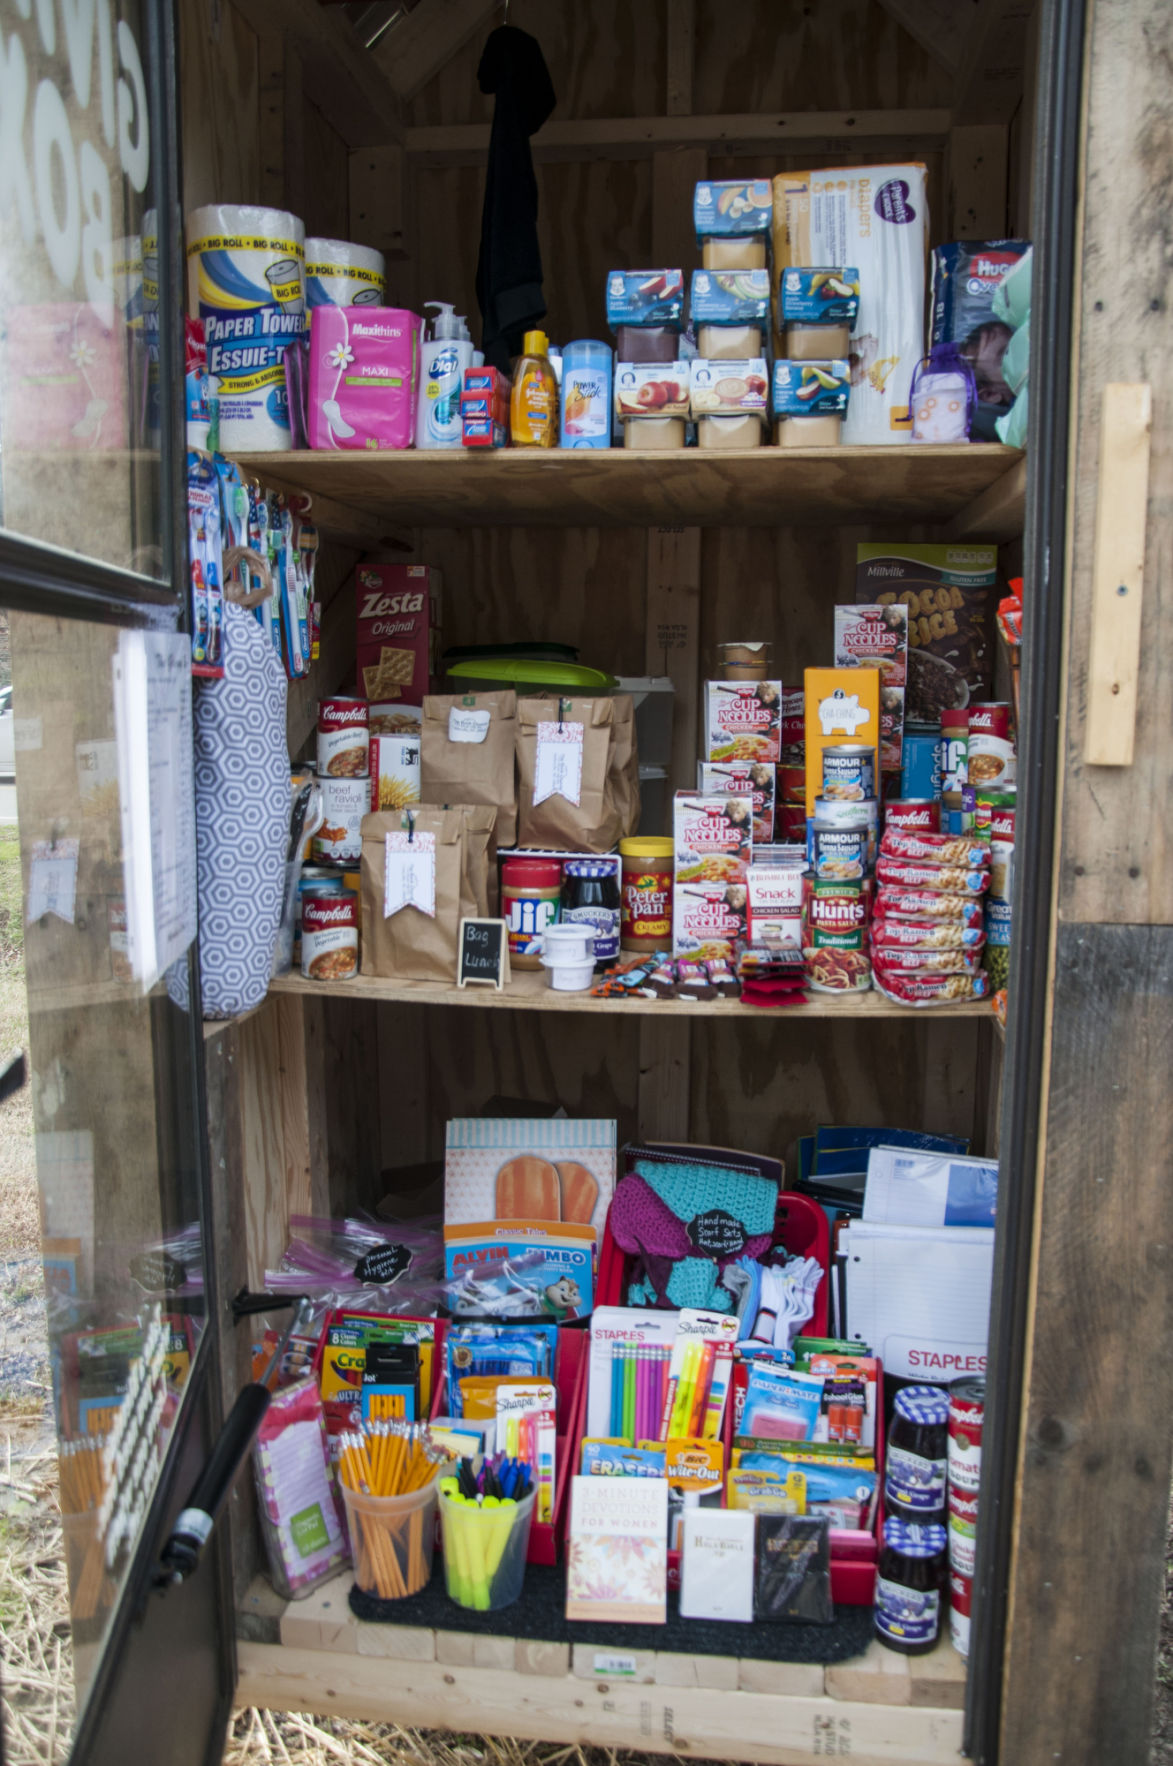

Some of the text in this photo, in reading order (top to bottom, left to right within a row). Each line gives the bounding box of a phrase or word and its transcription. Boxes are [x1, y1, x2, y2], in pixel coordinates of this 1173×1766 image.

[858, 178, 872, 238] Diapers
[208, 239, 288, 251] BIG ROLL BIG ROLL
[315, 266, 334, 275] ROLL
[356, 271, 372, 282] ROLL
[276, 287, 289, 297] BIG
[352, 323, 401, 338] Maxithins
[362, 366, 389, 376] MAXI
[430, 359, 457, 373] Dial
[868, 566, 904, 577] Millville
[359, 591, 424, 618] Zesta
[876, 586, 966, 619] COCOA
[372, 619, 415, 636] Original
[856, 622, 887, 634] CUP
[844, 633, 897, 646] NOODLES
[731, 699, 761, 712] CUP
[323, 705, 368, 722] Campbell's
[719, 710, 772, 723] NOODLES
[943, 741, 968, 770] if
[824, 758, 861, 767] ARMOUR
[931, 744, 942, 800] spaghe
[329, 785, 351, 796] beef
[335, 793, 363, 804] ravioli
[886, 808, 931, 826] Campbell's
[698, 817, 730, 830] CUP
[684, 829, 741, 843] NOODLES
[819, 833, 860, 843] ARMOUR
[907, 848, 925, 857] BEEF
[910, 842, 943, 852] Ramen
[904, 875, 921, 883] BEEF
[906, 868, 940, 879] Ramen
[626, 885, 668, 907] Peter
[755, 887, 796, 900] Snack
[900, 902, 918, 911] BEEF
[904, 896, 936, 907] Ramen
[304, 904, 353, 920] Campbell's
[697, 904, 730, 916] CUP
[812, 899, 864, 920] Hunt's
[505, 902, 554, 933] Jif
[684, 916, 741, 928] NOODLES
[902, 927, 935, 936] Ramen
[989, 923, 1011, 932] SWEE
[315, 936, 341, 949] Vegetable
[466, 926, 489, 947] Bag
[817, 935, 858, 945] Traditional
[900, 934, 918, 943] BEEF
[465, 951, 501, 969] Lunch
[904, 951, 937, 959] Ramen
[902, 958, 920, 966] BEEF
[915, 983, 947, 992] Ramen
[453, 1246, 509, 1267] ALVIN
[595, 1329, 645, 1341] STAPLES
[676, 1322, 717, 1336] Sharpie
[332, 1334, 339, 1344] 8
[338, 1353, 365, 1368] Cra
[908, 1349, 987, 1373] STAPLES
[364, 1373, 376, 1382] Jot
[823, 1393, 847, 1402] School
[496, 1396, 535, 1412] Sharpie
[686, 1456, 707, 1464] BIC
[950, 1457, 980, 1474] omat
[668, 1465, 720, 1479] Wite-Out
[582, 1487, 659, 1499] 3-MINUTE
[582, 1503, 659, 1514] DEVOTIONS
[582, 1518, 658, 1529] FOR WOMEN
[664, 1706, 674, 1743] SELECT
